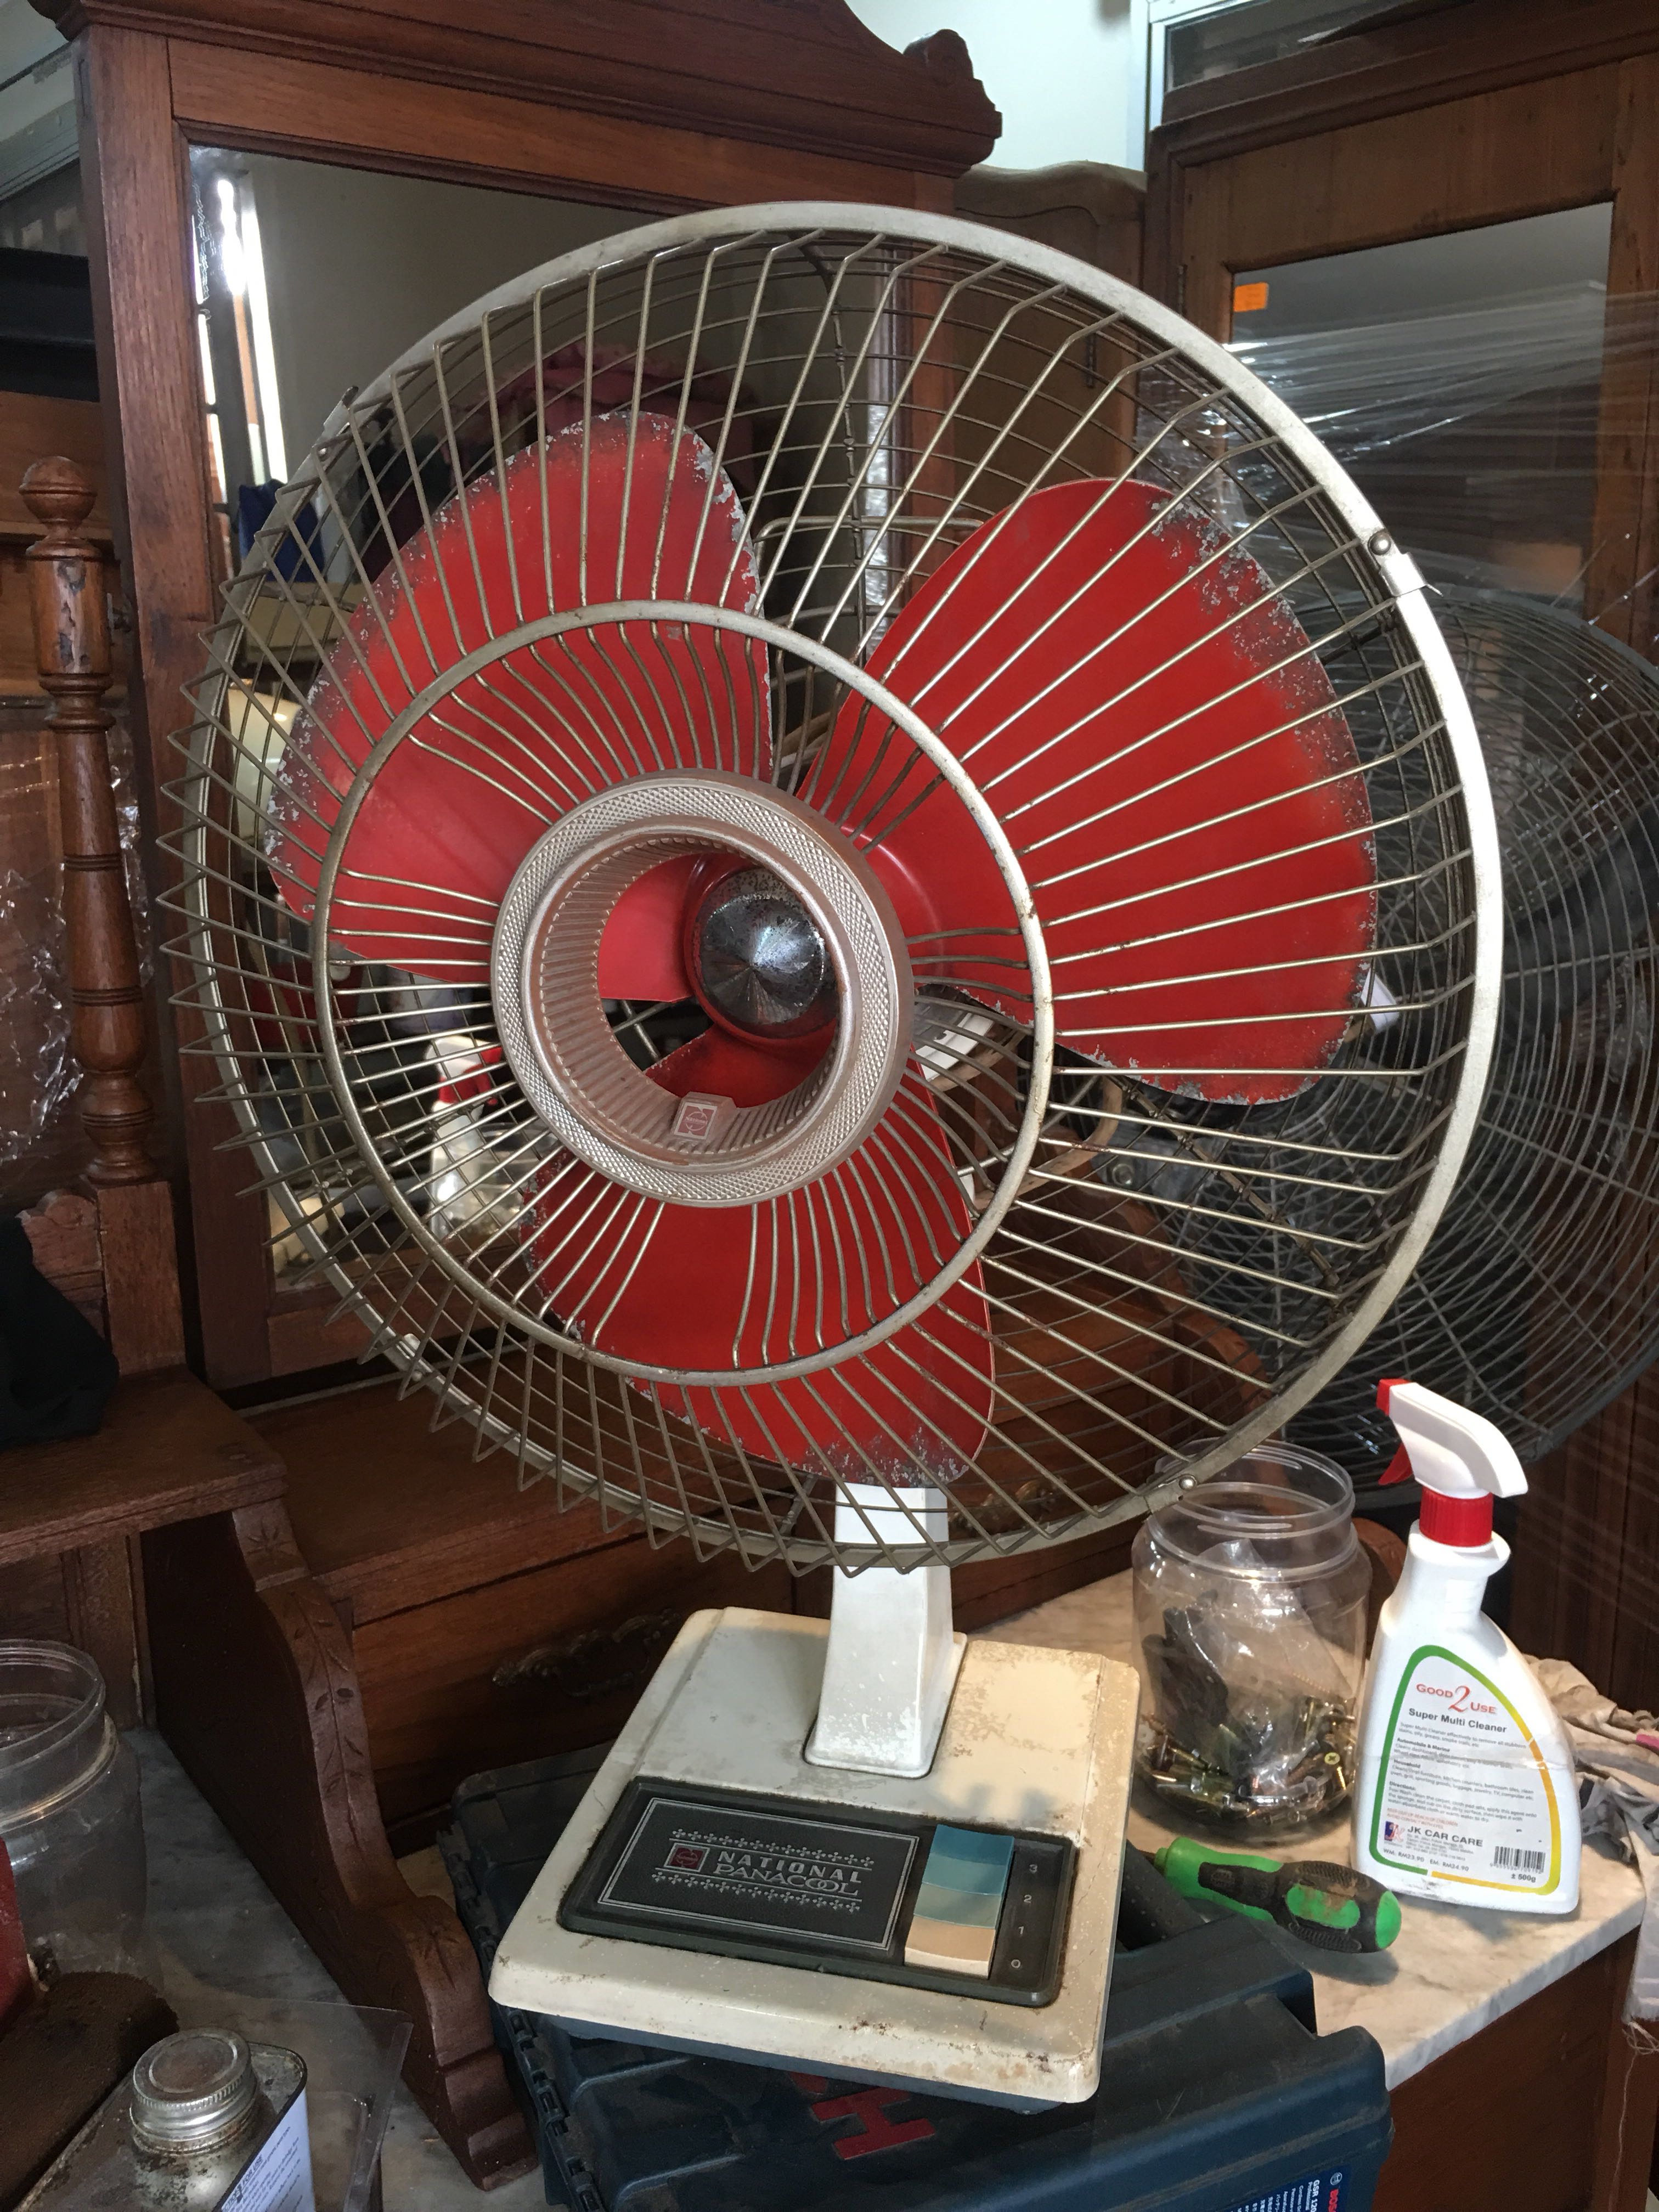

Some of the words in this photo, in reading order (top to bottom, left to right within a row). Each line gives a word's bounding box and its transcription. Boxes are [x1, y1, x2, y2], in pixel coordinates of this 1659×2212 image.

[1448, 1685, 1470, 1713] 2
[1408, 1707, 1441, 1720] Super
[1441, 1714, 1465, 1726] Multi
[1468, 1720, 1508, 1733] Cleaner
[1407, 1825, 1422, 1835] JK
[1425, 1829, 1448, 1840] CAR
[1452, 1835, 1483, 1847] CARE
[718, 1851, 863, 1883] NATIONAL
[1029, 1864, 1038, 1874] 3
[714, 1863, 859, 1896] PANACOOL
[1517, 1874, 1537, 1883] 500g
[1023, 1894, 1032, 1903] 2
[1018, 1926, 1024, 1935] 1
